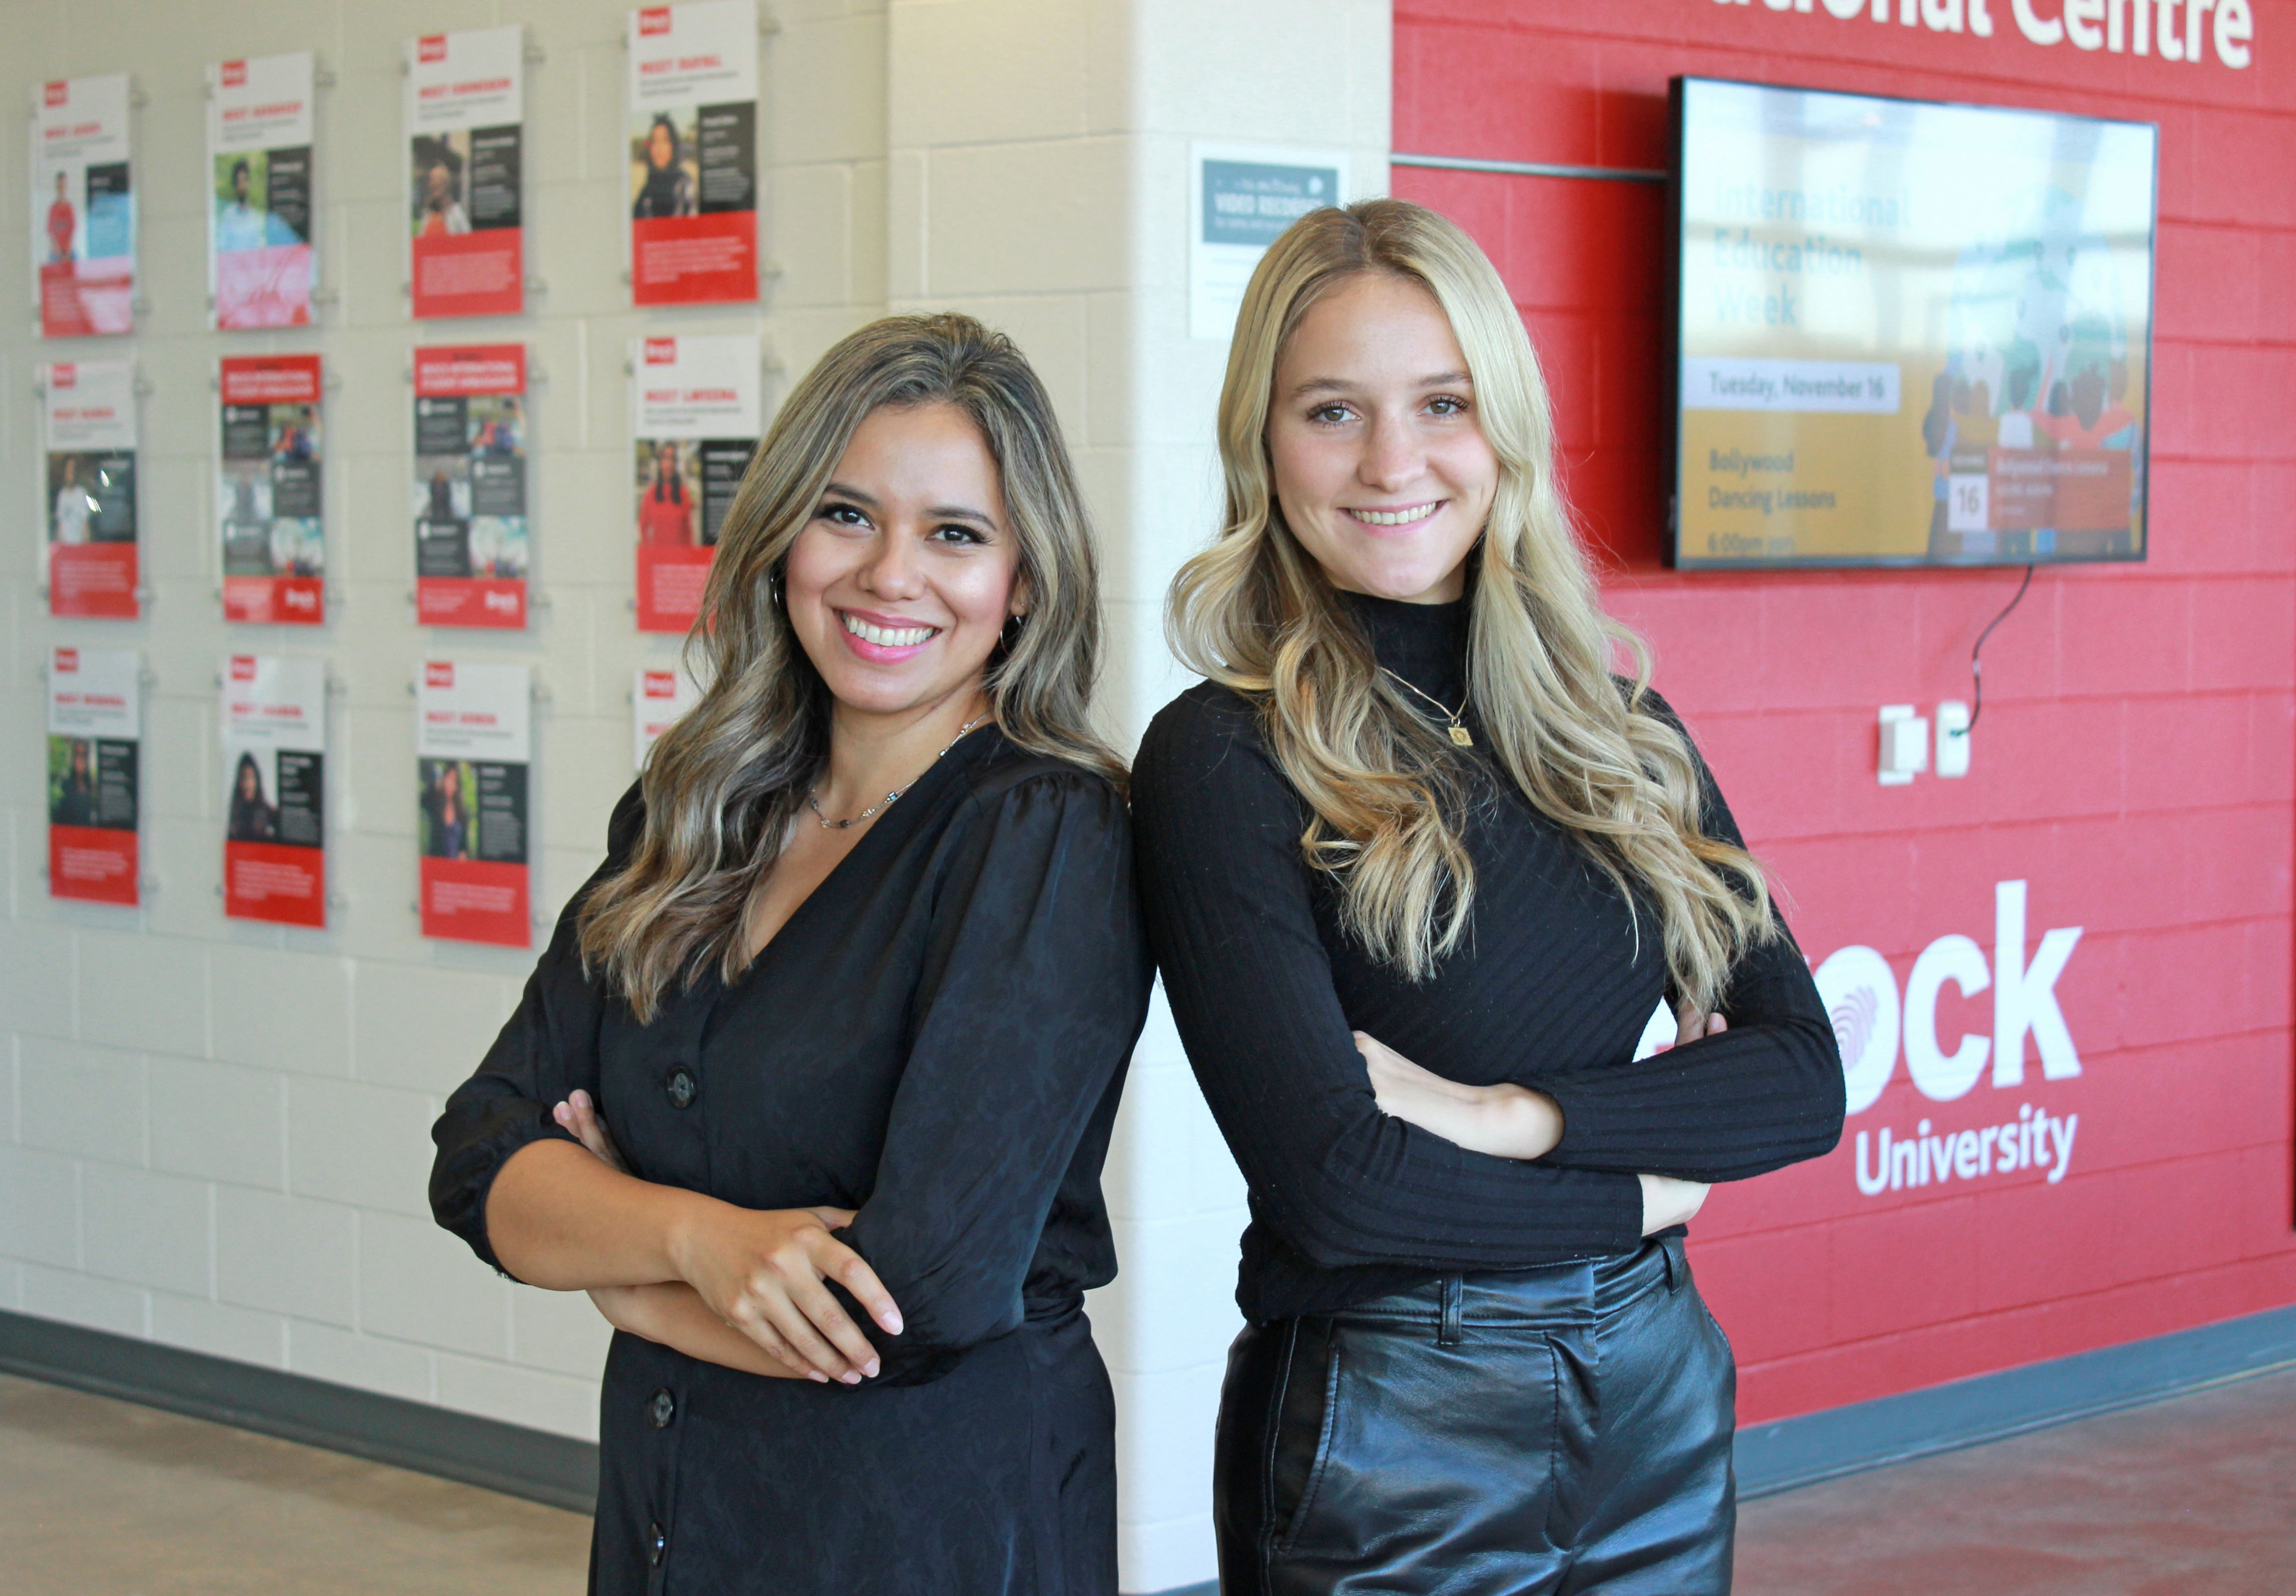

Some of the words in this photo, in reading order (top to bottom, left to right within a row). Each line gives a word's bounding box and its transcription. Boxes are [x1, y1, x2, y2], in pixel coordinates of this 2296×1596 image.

[1715, 180, 1910, 228] International
[1715, 228, 1862, 274] Education
[1713, 282, 1796, 325] Week
[1710, 371, 1776, 401] Tuesday,
[1783, 373, 1862, 399] November
[1867, 375, 1884, 400] 16
[1709, 448, 1794, 478] Bollywood
[1709, 486, 1774, 515] Dancing
[1777, 488, 1836, 509] Lessons
[1958, 484, 1980, 514] 16
[1632, 879, 2084, 1116] ock
[1855, 1102, 2079, 1196] University
